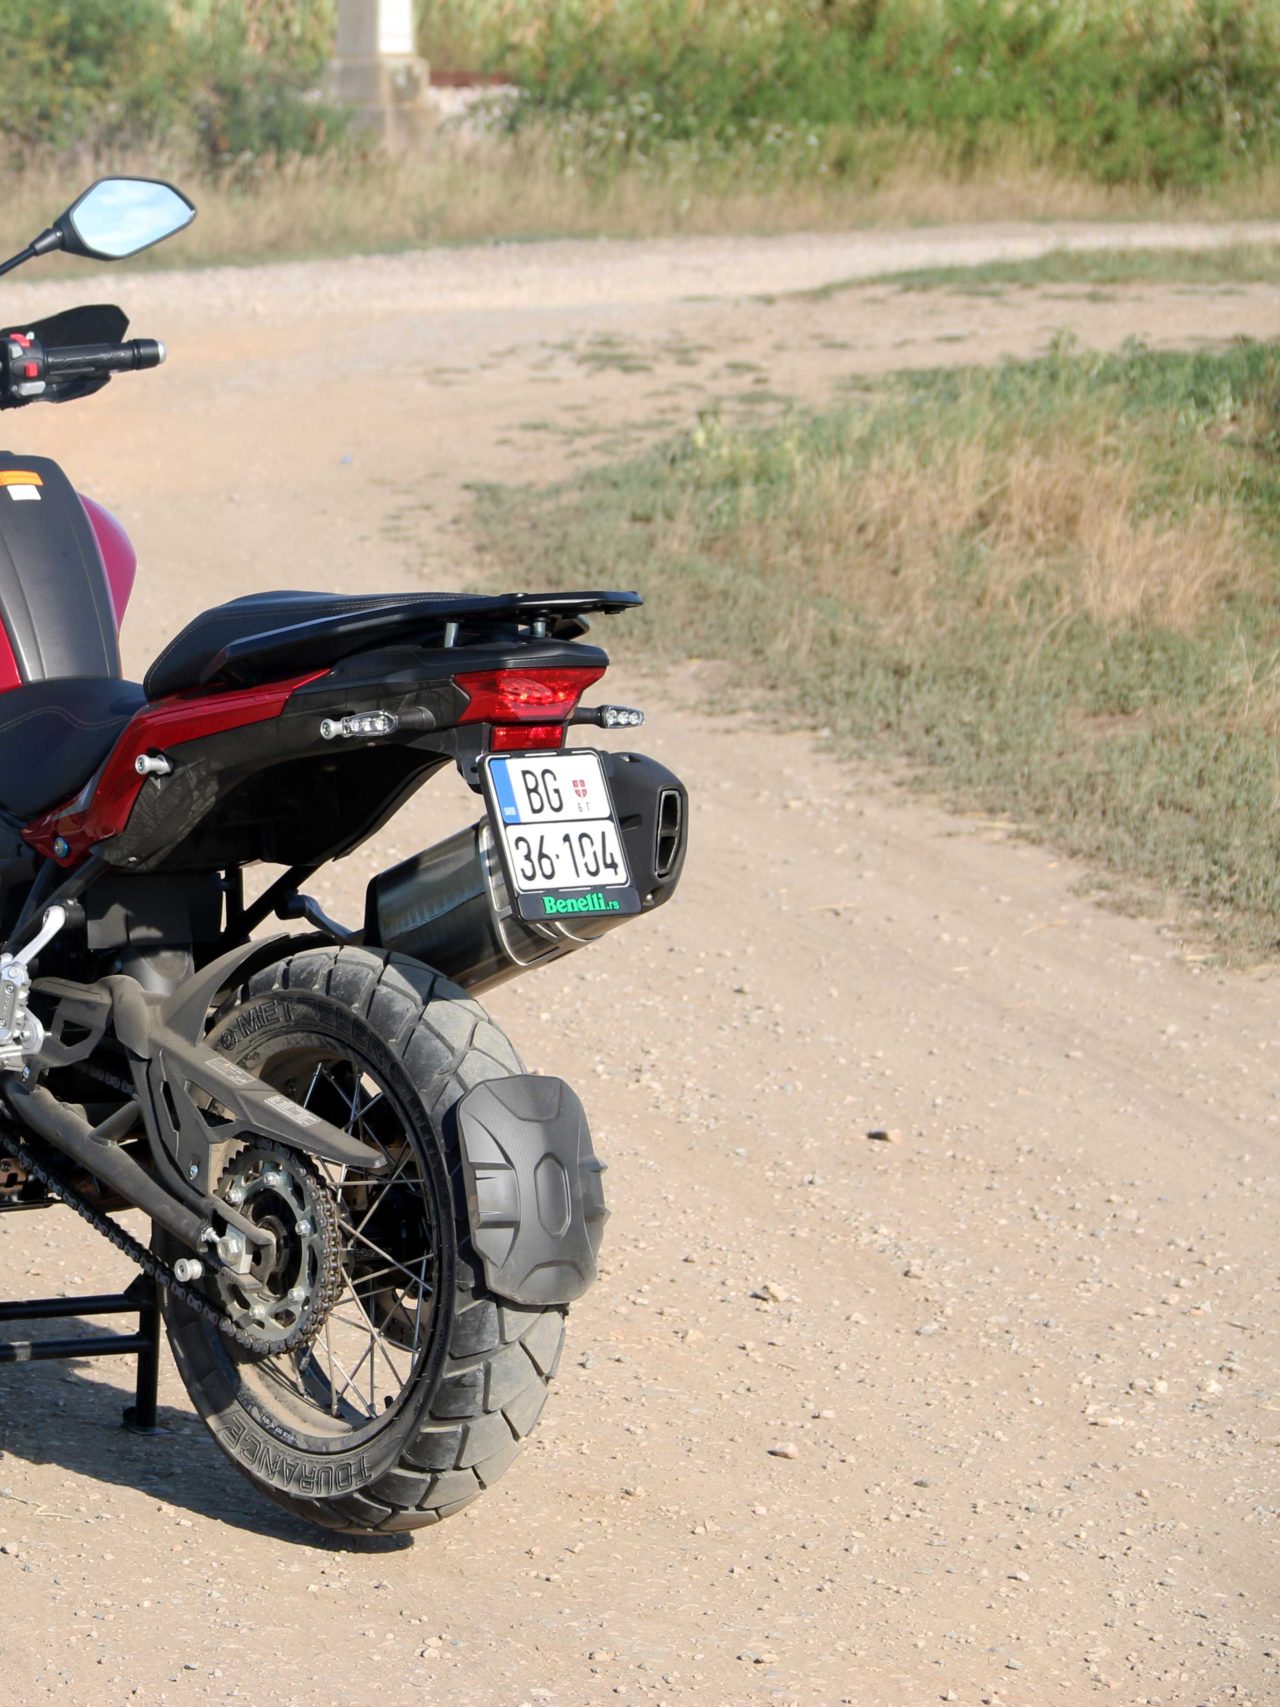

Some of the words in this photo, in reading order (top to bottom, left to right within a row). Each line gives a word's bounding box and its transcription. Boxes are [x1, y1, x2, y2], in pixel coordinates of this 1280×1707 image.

[521, 768, 563, 814] BG
[542, 893, 620, 915] Benelli.rs
[221, 1414, 373, 1494] TOURANCE
